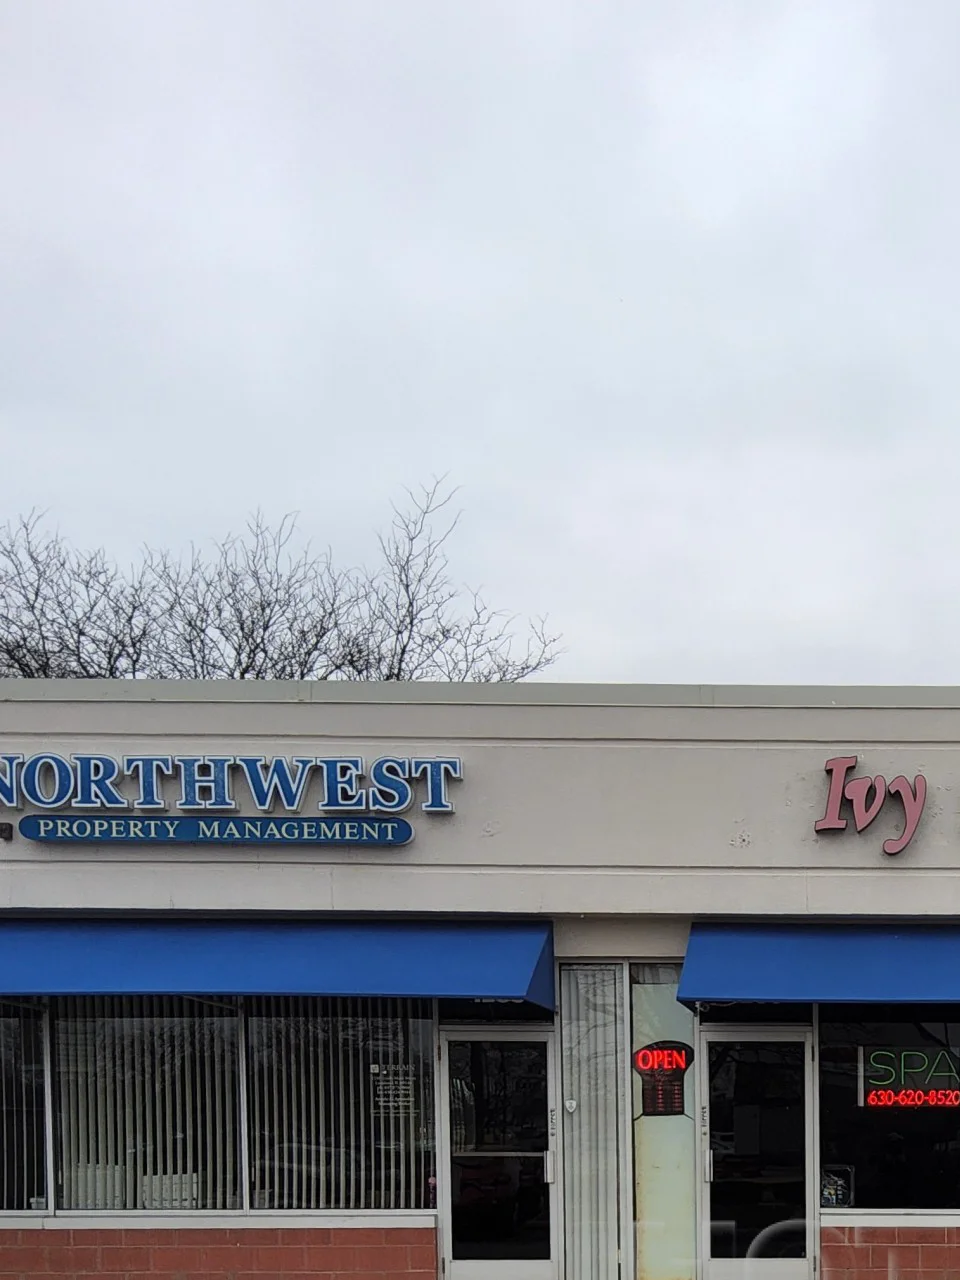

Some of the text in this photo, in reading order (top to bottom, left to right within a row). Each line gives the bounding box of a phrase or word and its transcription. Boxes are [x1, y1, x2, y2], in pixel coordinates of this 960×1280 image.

[814, 755, 928, 856] Ivy
[38, 819, 398, 841] PROPERTY MANAGEMENT
[637, 1049, 686, 1070] OPEN
[868, 1050, 960, 1086] SPA
[867, 1089, 960, 1106] 630-620-8520
